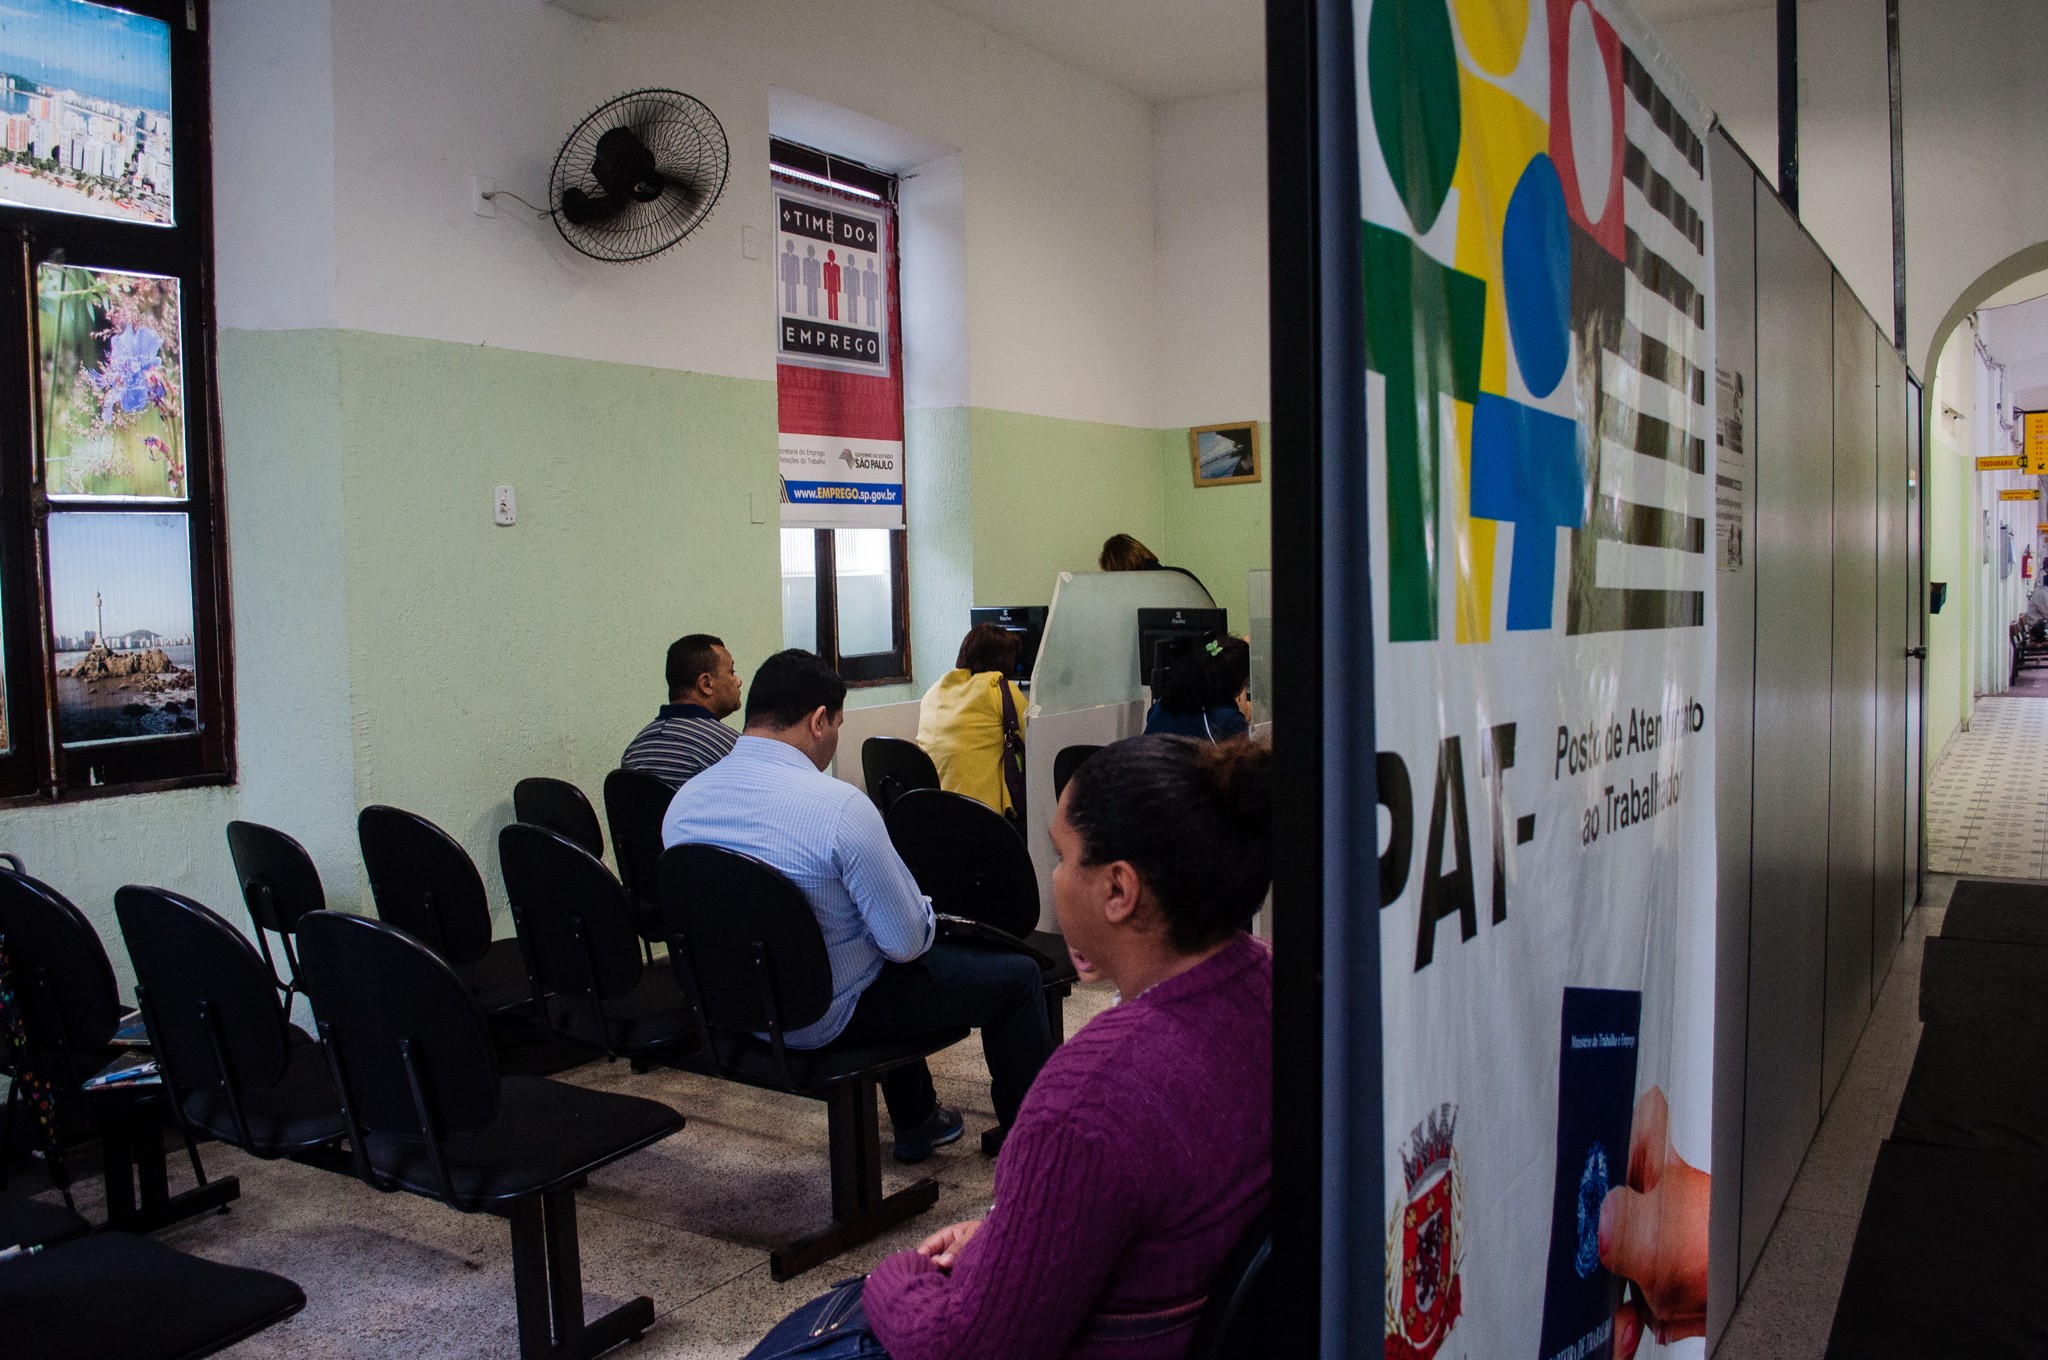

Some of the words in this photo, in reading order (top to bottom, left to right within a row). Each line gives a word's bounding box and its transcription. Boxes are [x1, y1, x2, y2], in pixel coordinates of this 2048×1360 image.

[793, 210, 835, 235] TIME
[843, 223, 865, 242] DO
[786, 326, 877, 354] EMPREGO
[870, 459, 894, 470] PAULO
[793, 487, 897, 503] www.EMPREGO.sp.gov.br
[1555, 720, 1600, 781] Posto
[1605, 712, 1623, 762] de
[1626, 695, 1704, 756] Atento
[1582, 804, 1600, 847] ao
